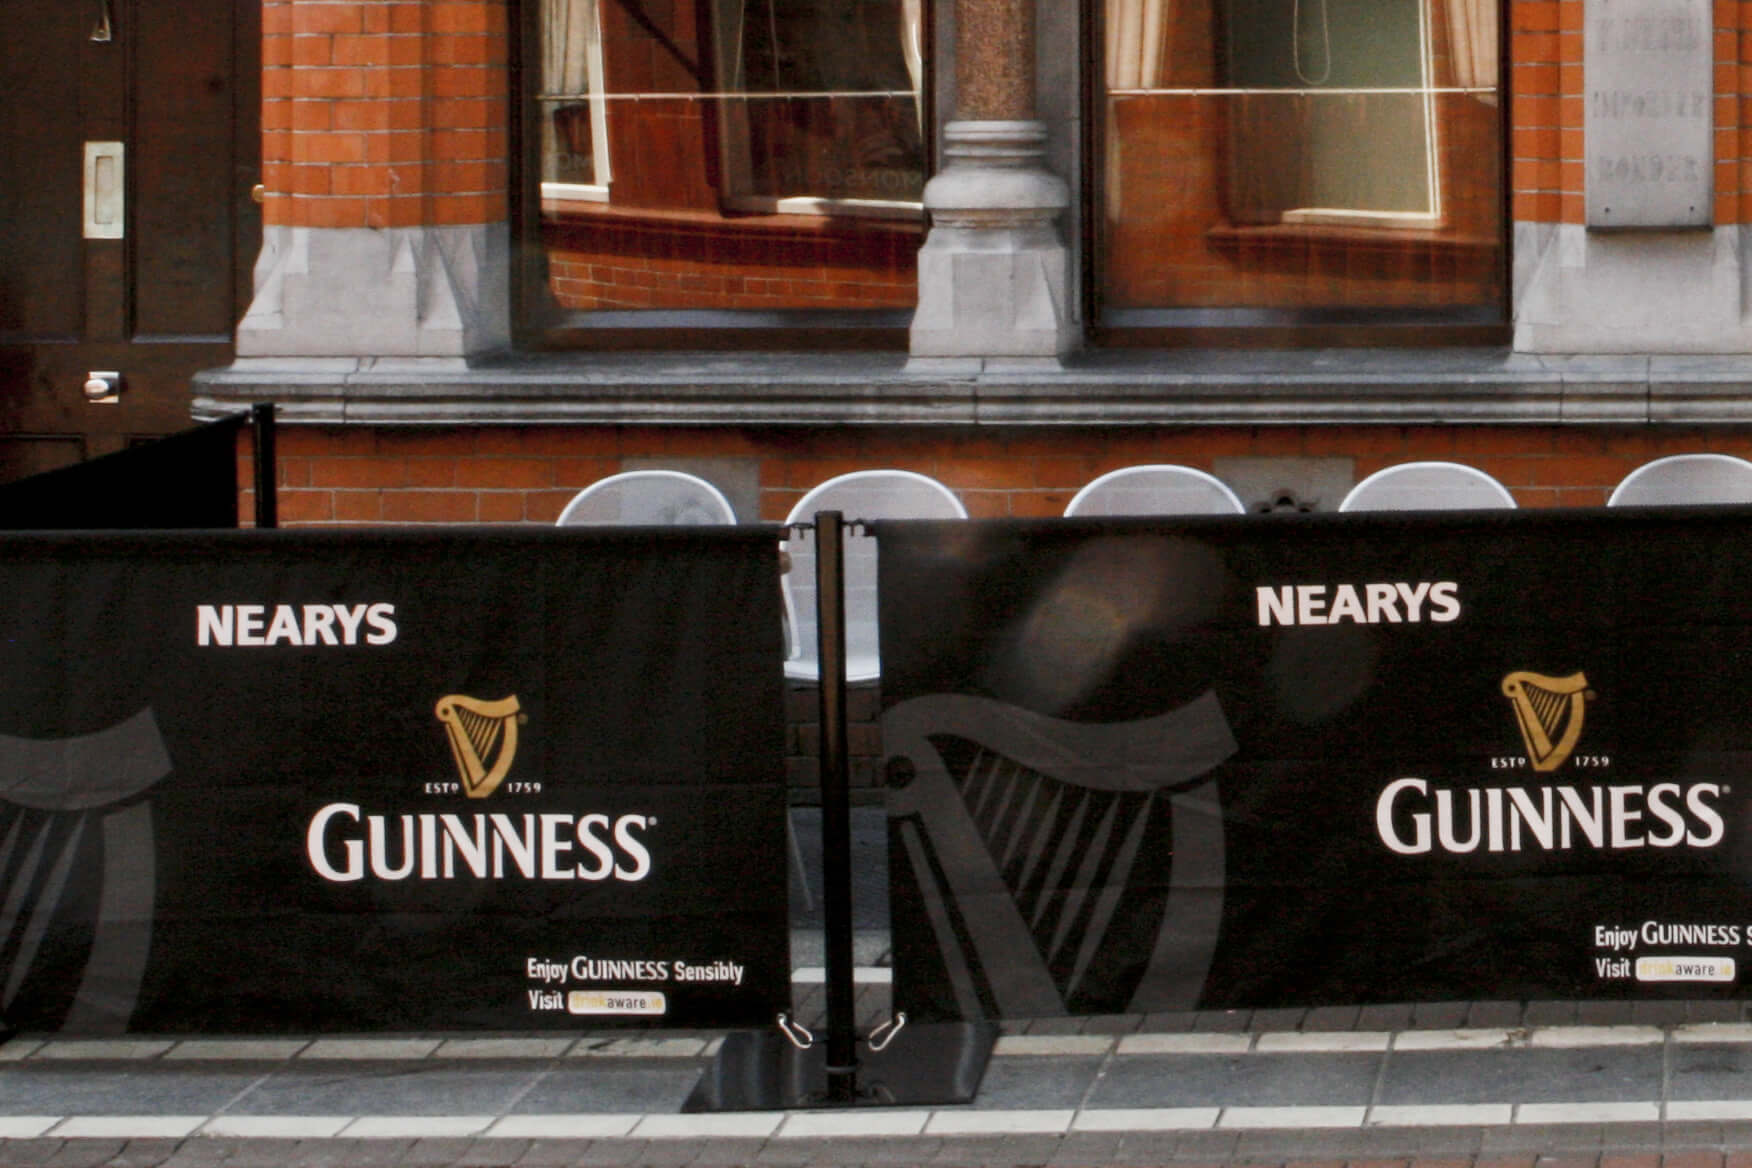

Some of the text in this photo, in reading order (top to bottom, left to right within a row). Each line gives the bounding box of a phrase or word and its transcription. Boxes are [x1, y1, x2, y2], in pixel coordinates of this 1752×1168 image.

[1256, 581, 1461, 626] NEARYS
[197, 602, 398, 646] NEARYS
[1575, 755, 1610, 768] 1759
[507, 781, 542, 793] 1759
[1376, 778, 1725, 855] GUINNESS
[307, 803, 651, 882] GUINNESS
[1594, 925, 1638, 951] Enjoy
[1640, 920, 1741, 945] GUINNESS
[527, 955, 744, 986] Enjoy GUINNESS Sensibly
[1595, 957, 1631, 978] Visit
[527, 989, 565, 1011] Visit
